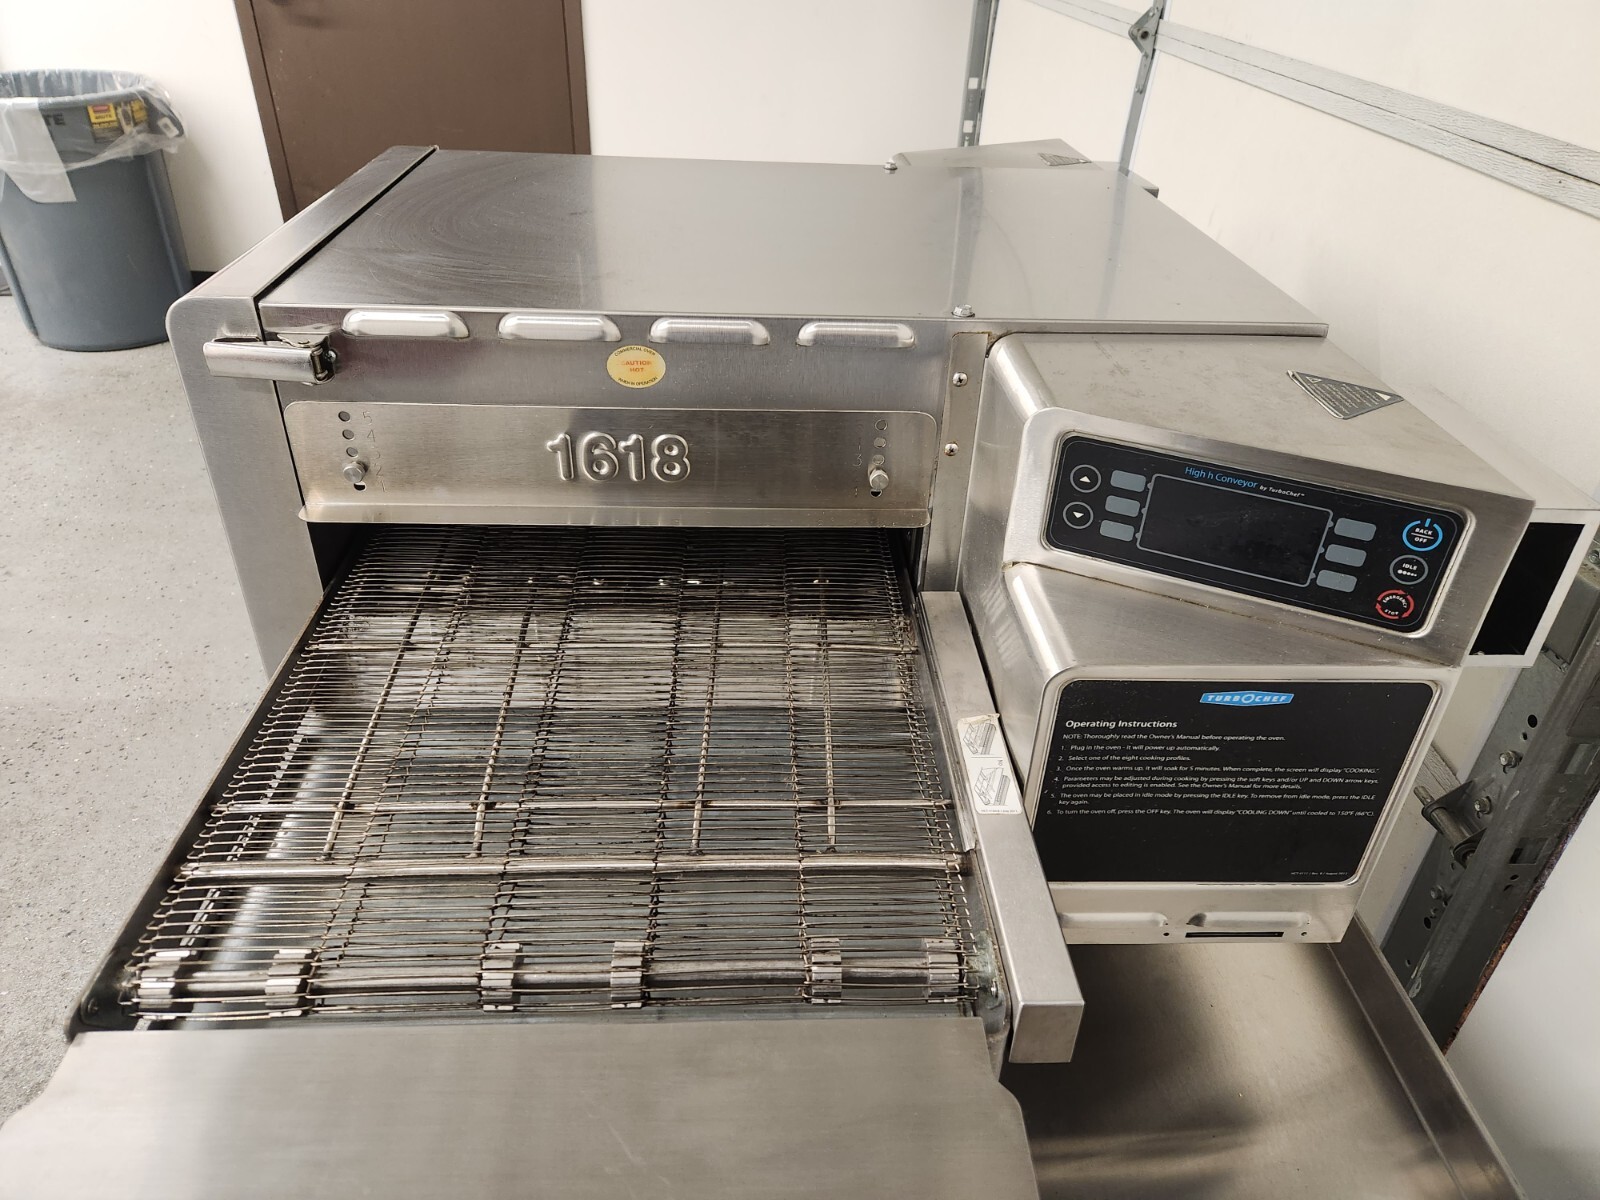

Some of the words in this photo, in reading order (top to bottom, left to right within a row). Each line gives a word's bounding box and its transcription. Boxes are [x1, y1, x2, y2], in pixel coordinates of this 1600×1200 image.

[614, 346, 642, 356] COMMERCIAL
[636, 376, 658, 386] OPERATION
[362, 411, 372, 425] 5
[367, 429, 376, 442] 4
[545, 431, 690, 482] 1618
[852, 454, 863, 467] 3
[1185, 466, 1205, 479] High
[1216, 473, 1258, 489] Conveyor
[1414, 527, 1433, 535] BACK
[1402, 563, 1418, 571] IDLE
[1382, 595, 1407, 608] EMERGENCY
[1207, 694, 1288, 704] TURBOCHEF
[1065, 720, 1116, 729] Operating
[1118, 720, 1178, 728] Instructions
